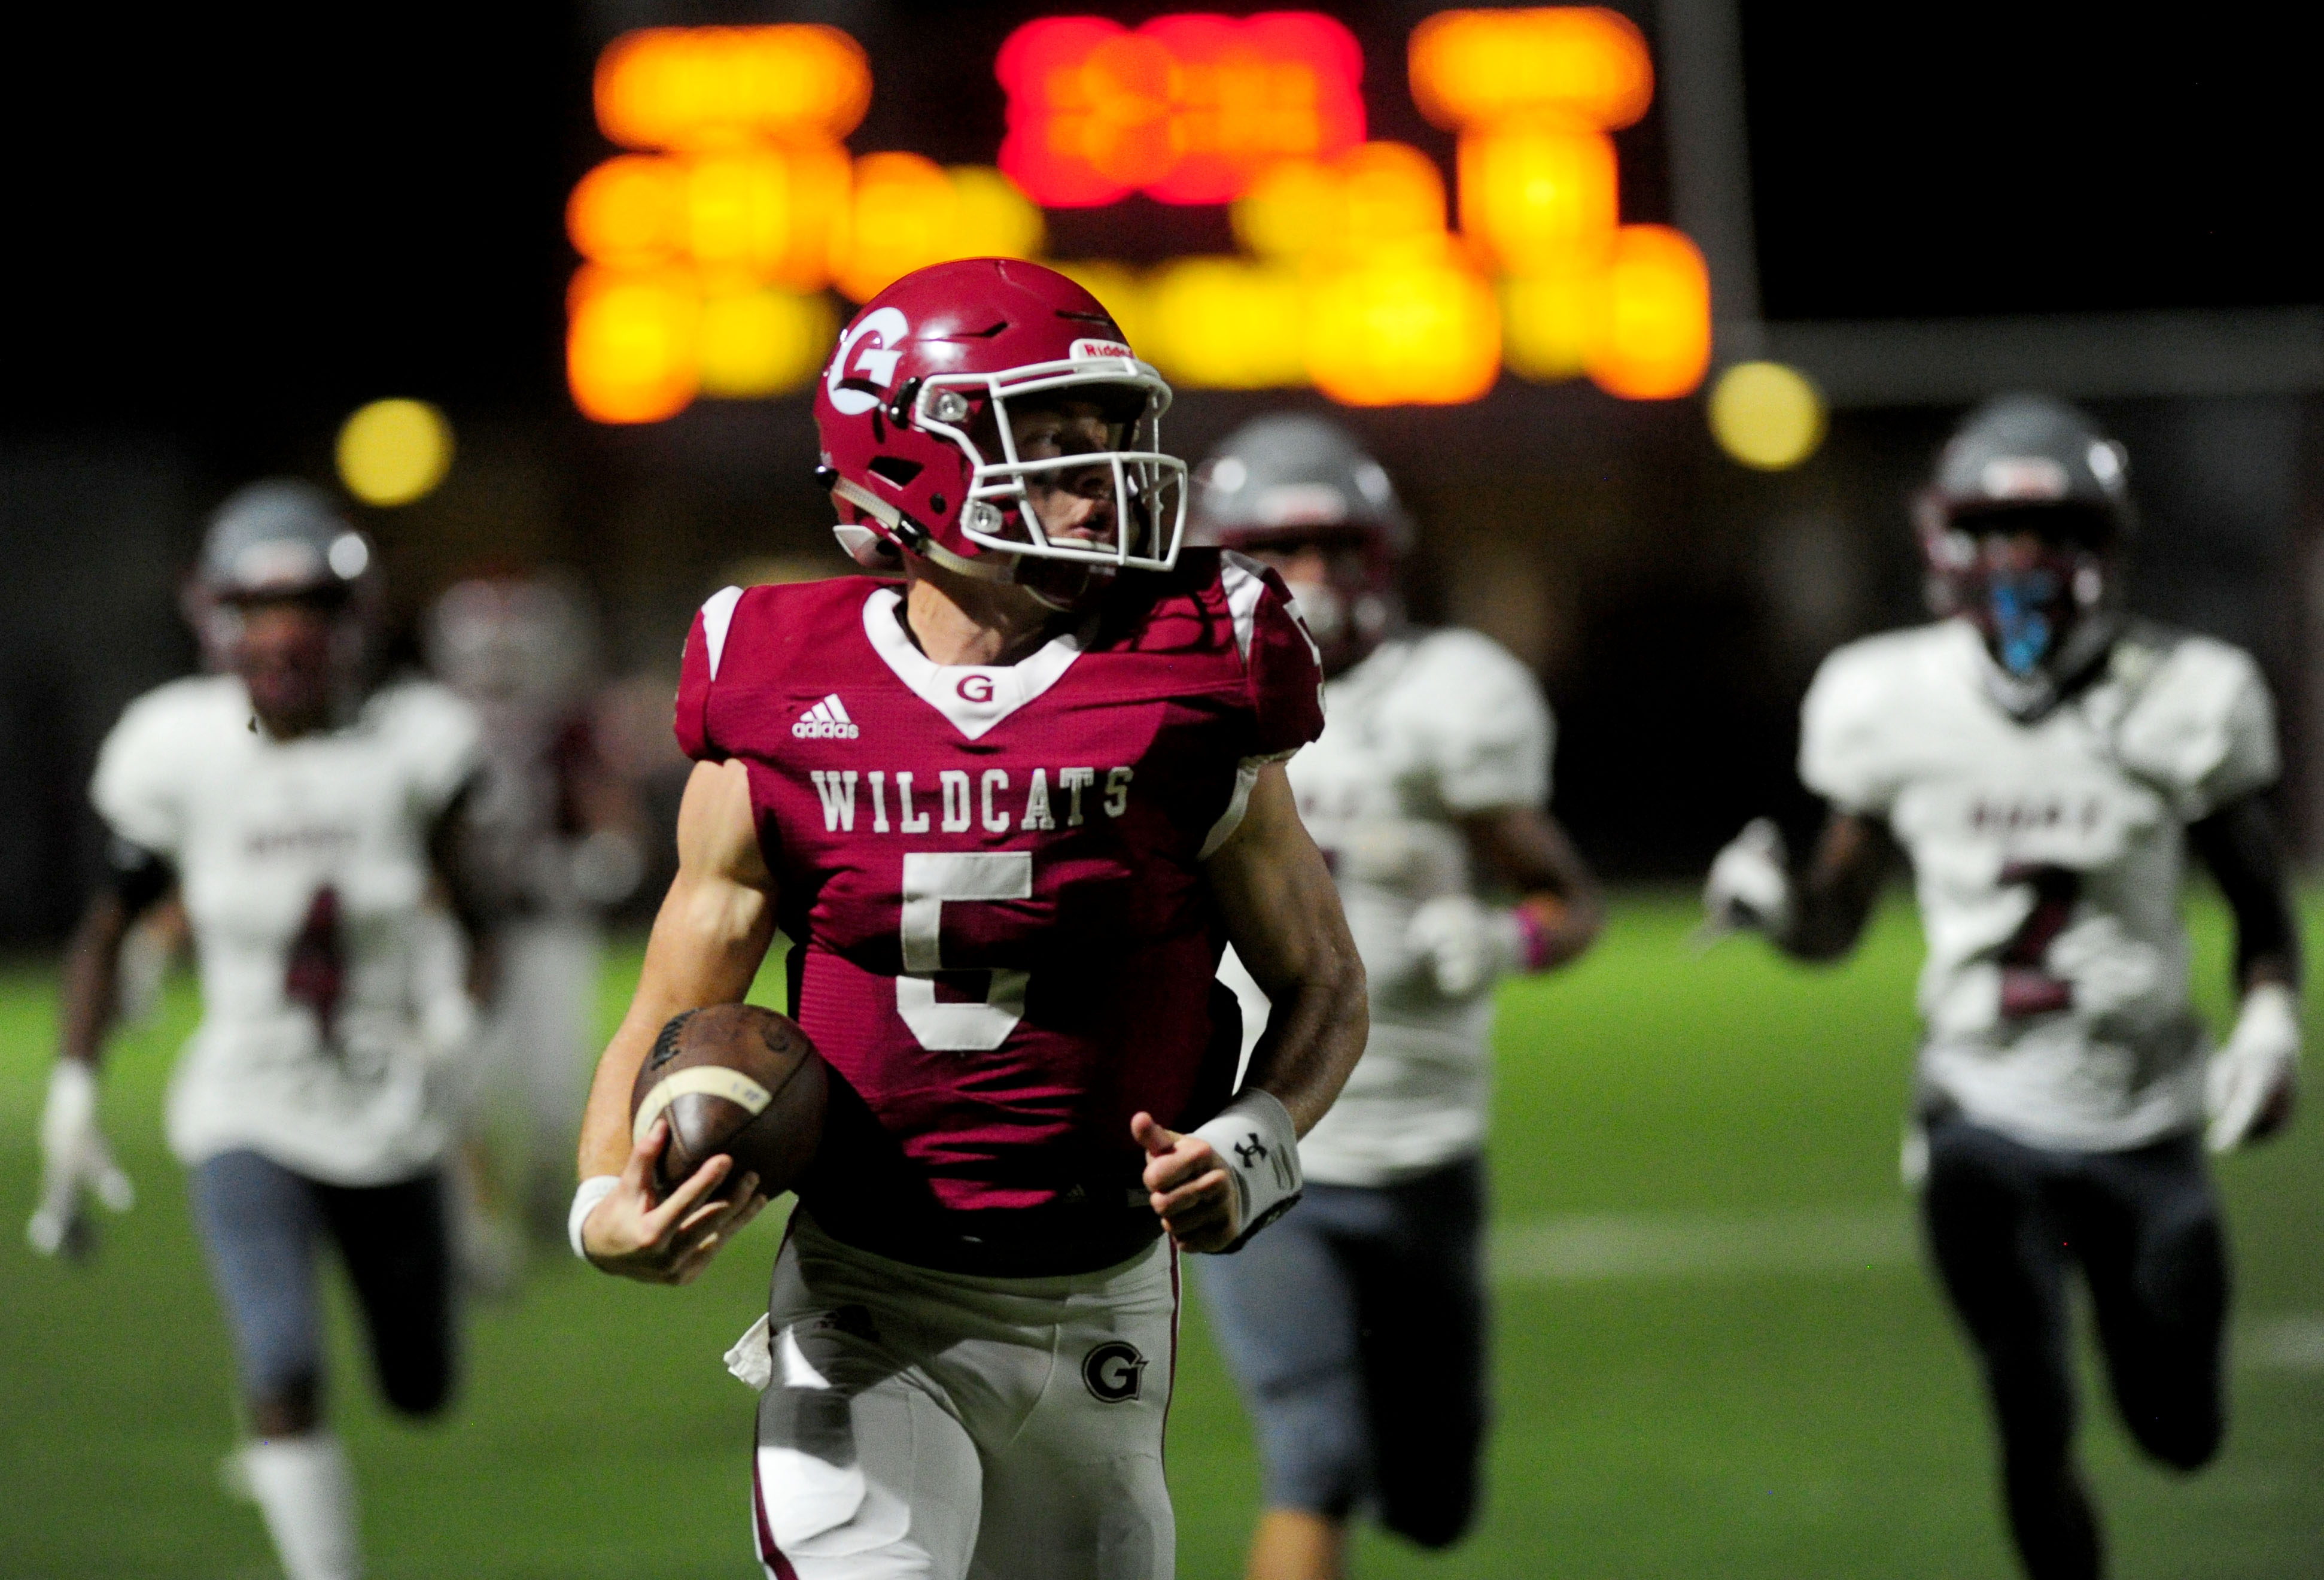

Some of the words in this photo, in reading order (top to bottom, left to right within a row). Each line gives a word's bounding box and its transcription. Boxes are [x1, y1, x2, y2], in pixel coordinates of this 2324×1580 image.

[828, 307, 909, 415] G
[956, 675, 994, 703] G
[791, 720, 859, 740] adidas
[810, 766, 1133, 834] WILDCATS
[895, 850, 1033, 1052] 5
[1081, 1341, 1148, 1403] G
